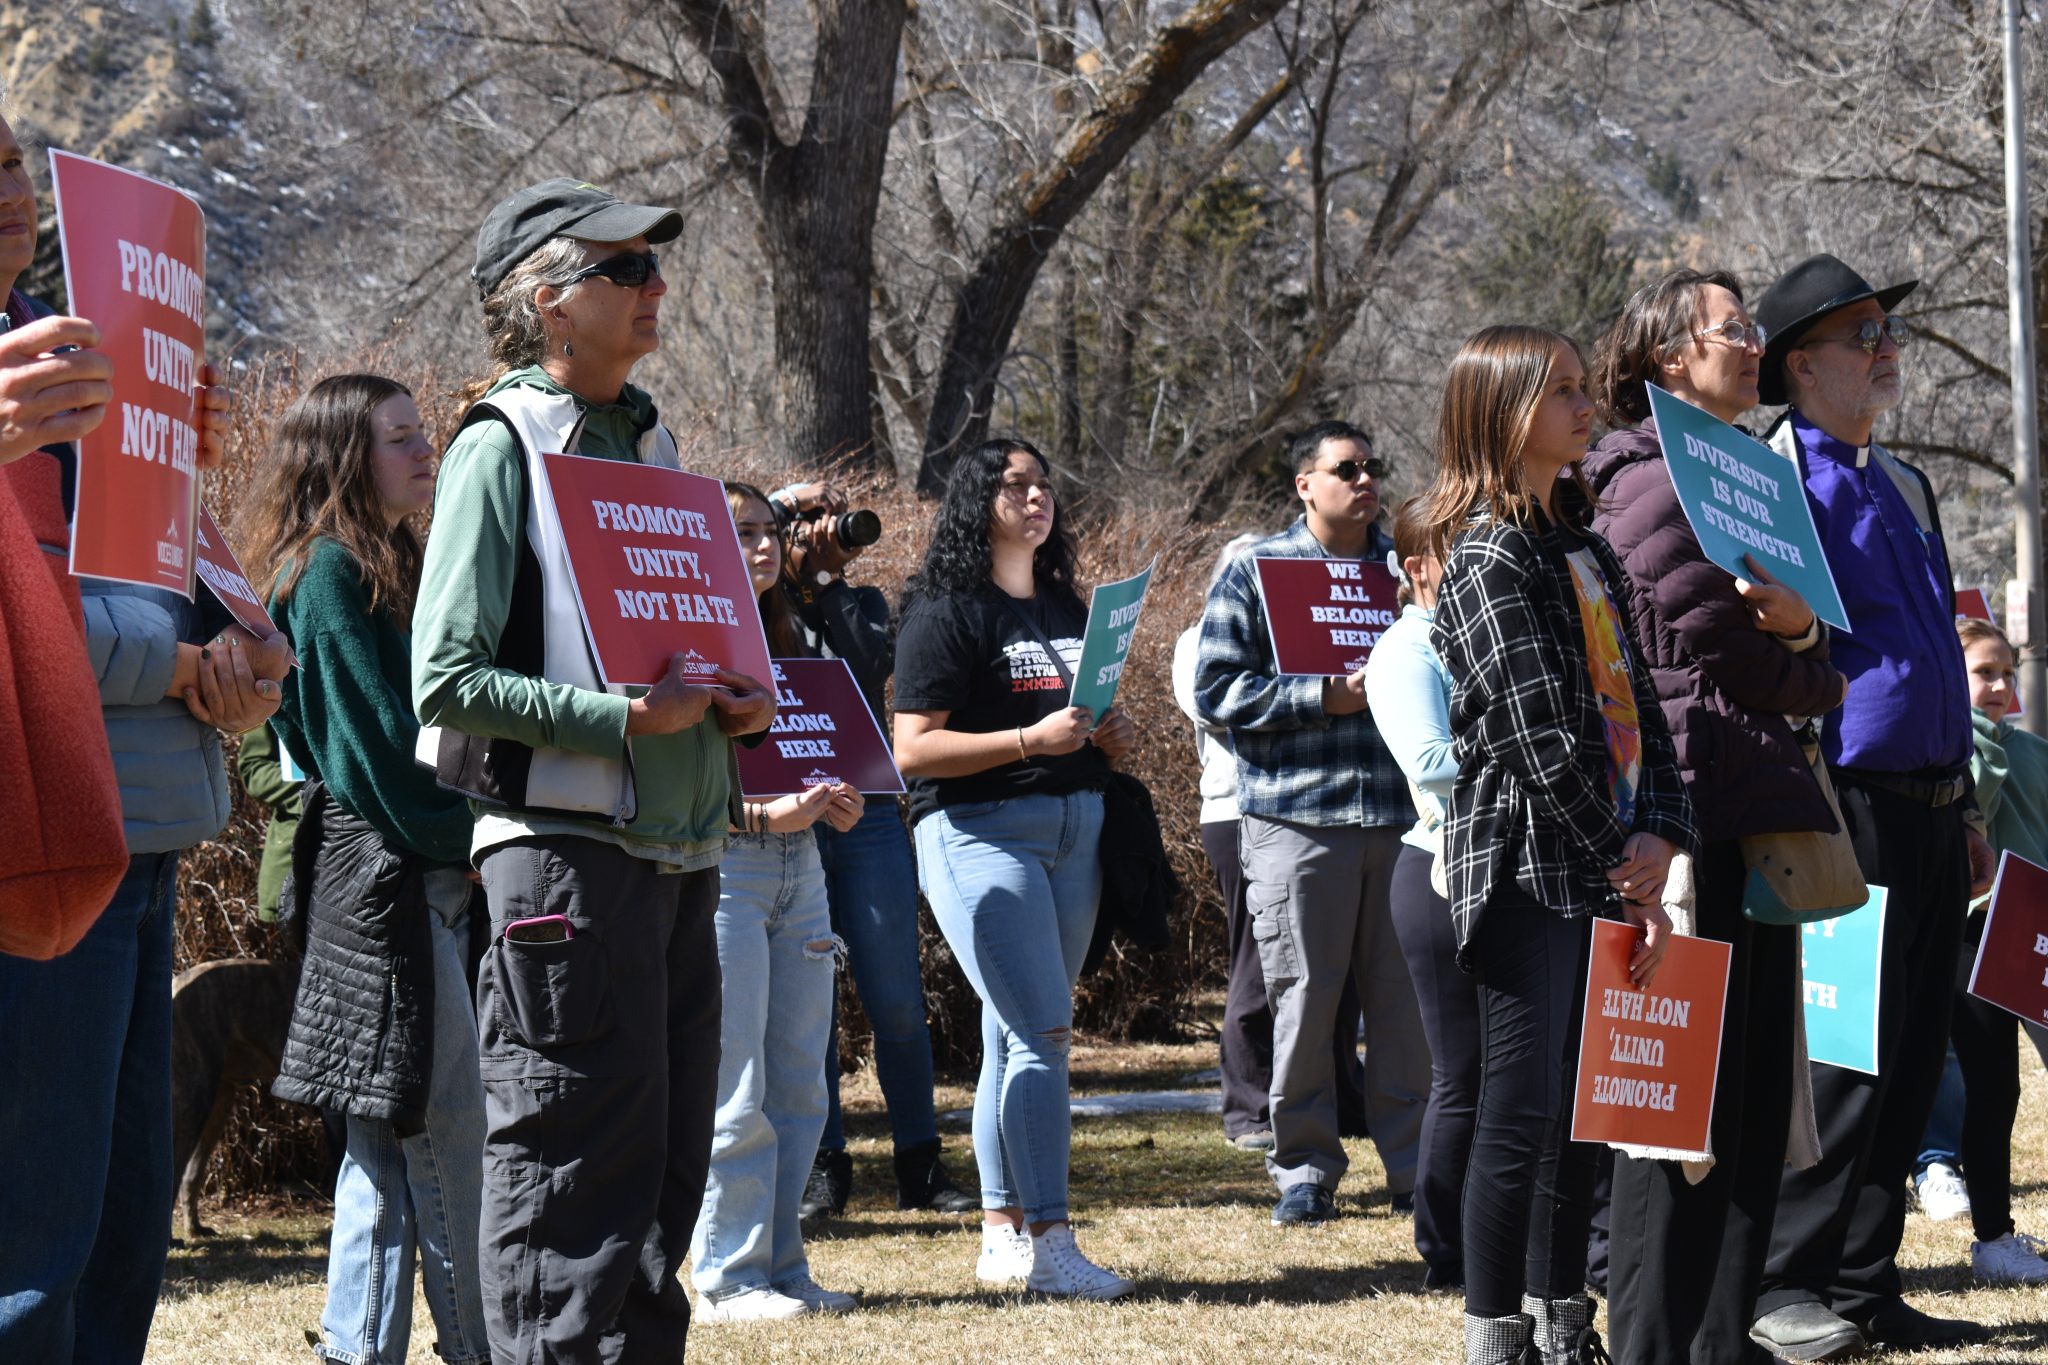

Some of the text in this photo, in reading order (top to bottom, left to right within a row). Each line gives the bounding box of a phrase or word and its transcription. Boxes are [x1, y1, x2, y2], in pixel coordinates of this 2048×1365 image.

[118, 239, 203, 329] PROMOTE
[121, 402, 198, 478] NOT HAT
[1682, 432, 1781, 502] DIVERSITY
[592, 500, 712, 541] PROMOTE
[1710, 476, 1774, 527] IS OUR
[1700, 501, 1805, 568] STRENGTH
[623, 546, 711, 588] UNITY,
[1325, 562, 1362, 579] WE
[614, 589, 739, 627] NOT HATE
[1329, 584, 1370, 602] ALL
[1310, 606, 1395, 626] BELONG
[776, 739, 836, 758] HERE
[1602, 988, 1690, 1029] NOT HATE
[1609, 1026, 1664, 1068] UNITY,
[1592, 1075, 1677, 1112] PROMOTE
